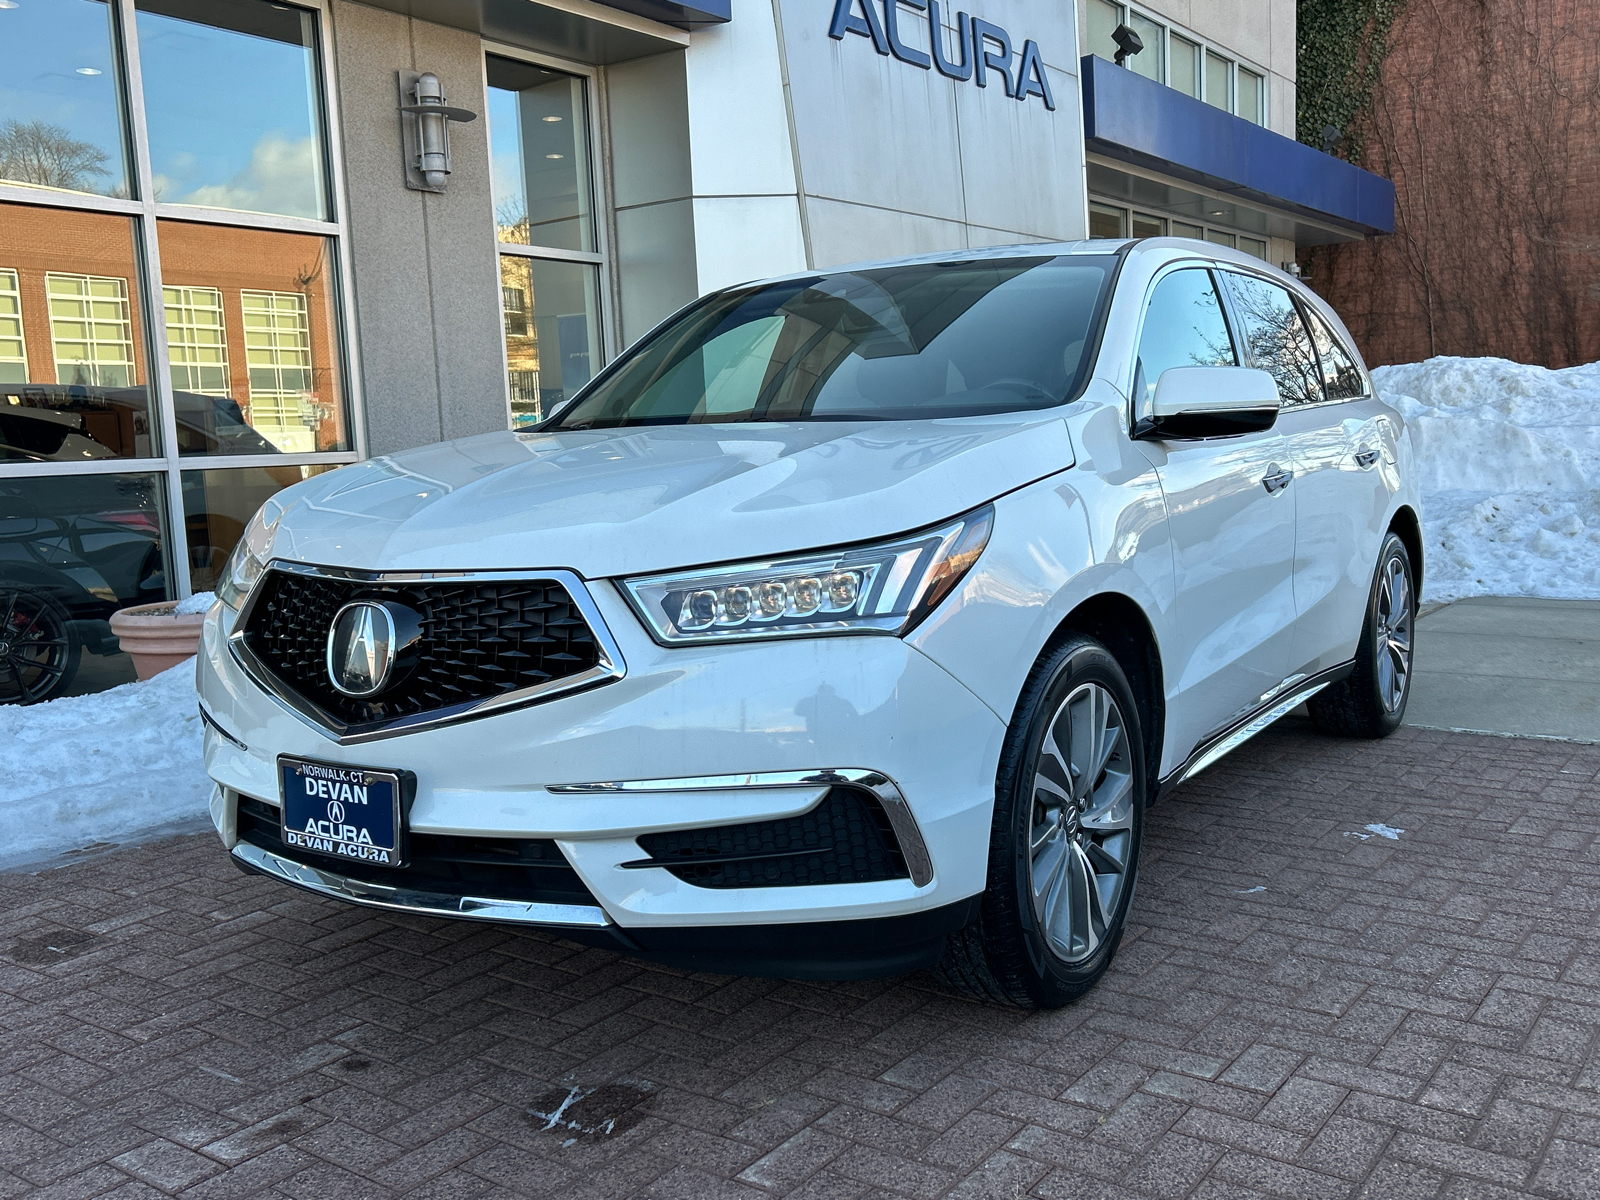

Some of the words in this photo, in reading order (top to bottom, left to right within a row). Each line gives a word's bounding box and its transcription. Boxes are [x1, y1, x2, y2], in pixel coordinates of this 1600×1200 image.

[828, 0, 1056, 111] ACURA
[305, 777, 368, 804] DEVAN
[350, 772, 363, 783] CT
[305, 818, 373, 845] ACURA
[287, 832, 333, 852] DEVAN
[337, 843, 389, 863] ACURA
